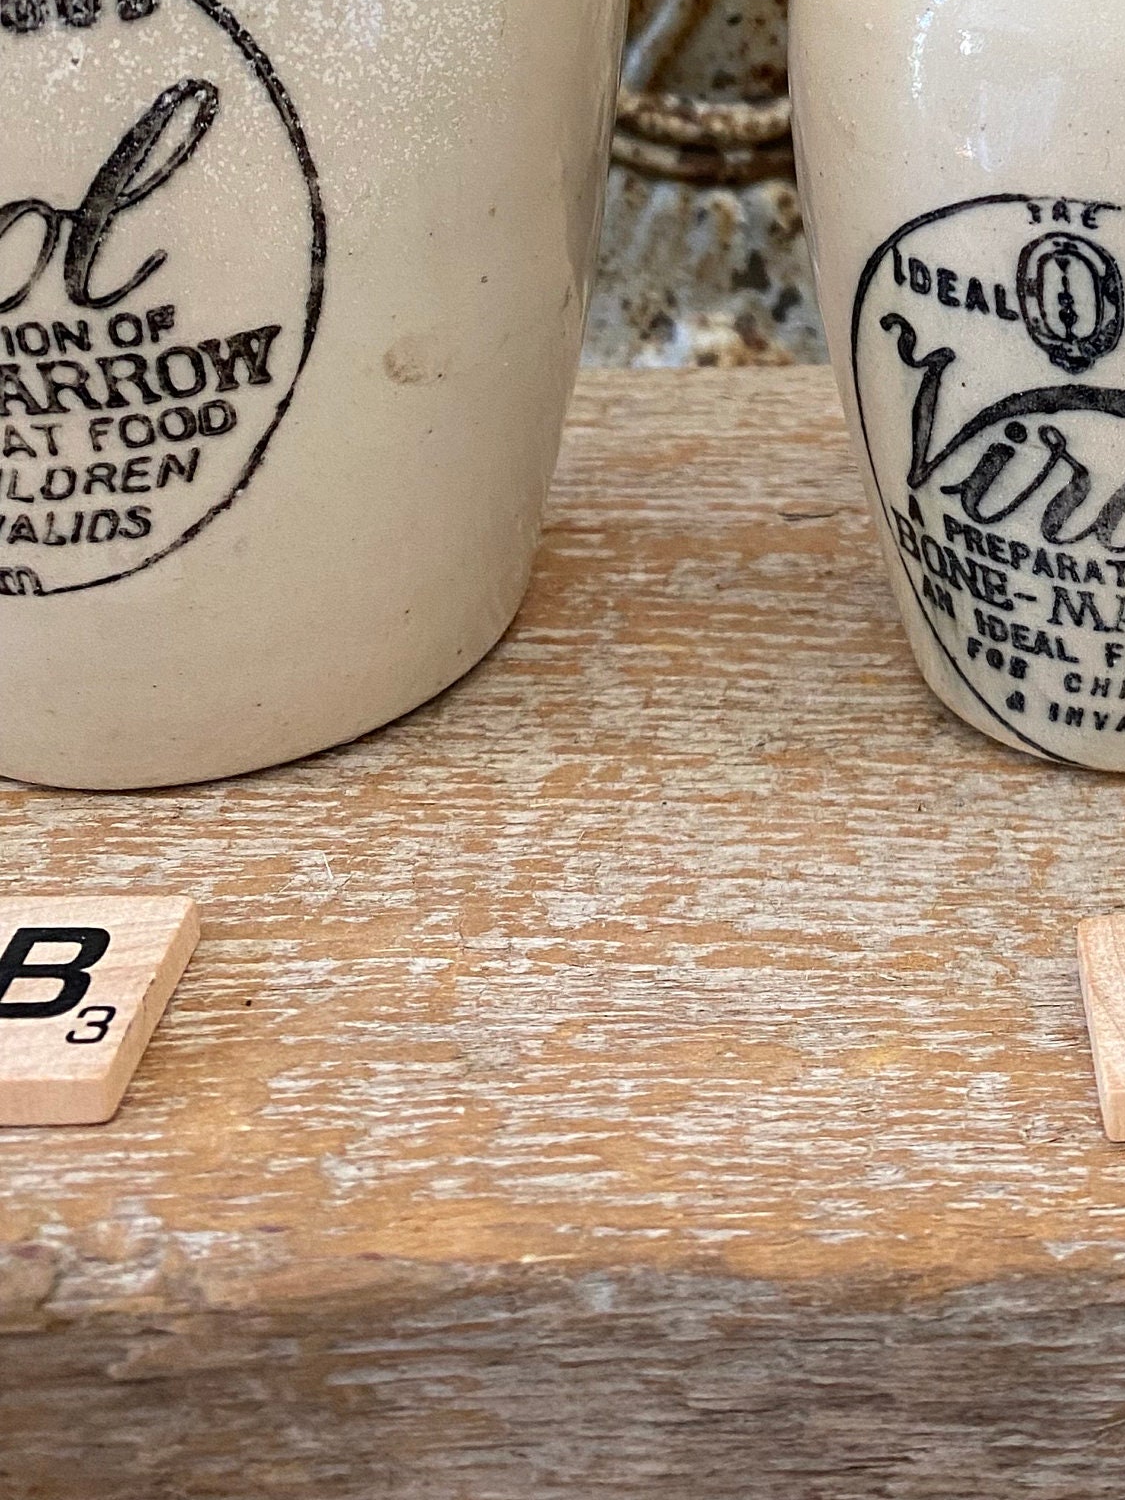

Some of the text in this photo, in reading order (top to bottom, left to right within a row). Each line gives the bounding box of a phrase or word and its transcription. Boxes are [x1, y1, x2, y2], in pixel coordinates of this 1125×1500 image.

[892, 246, 1019, 321] IDEAL
[108, 304, 175, 348] OF
[88, 399, 238, 451] FOOD
[0, 447, 200, 502] LDREN
[0, 505, 152, 546] ALIDS
[974, 607, 1080, 664] IDEAL
[0, 927, 117, 1044] B 3
